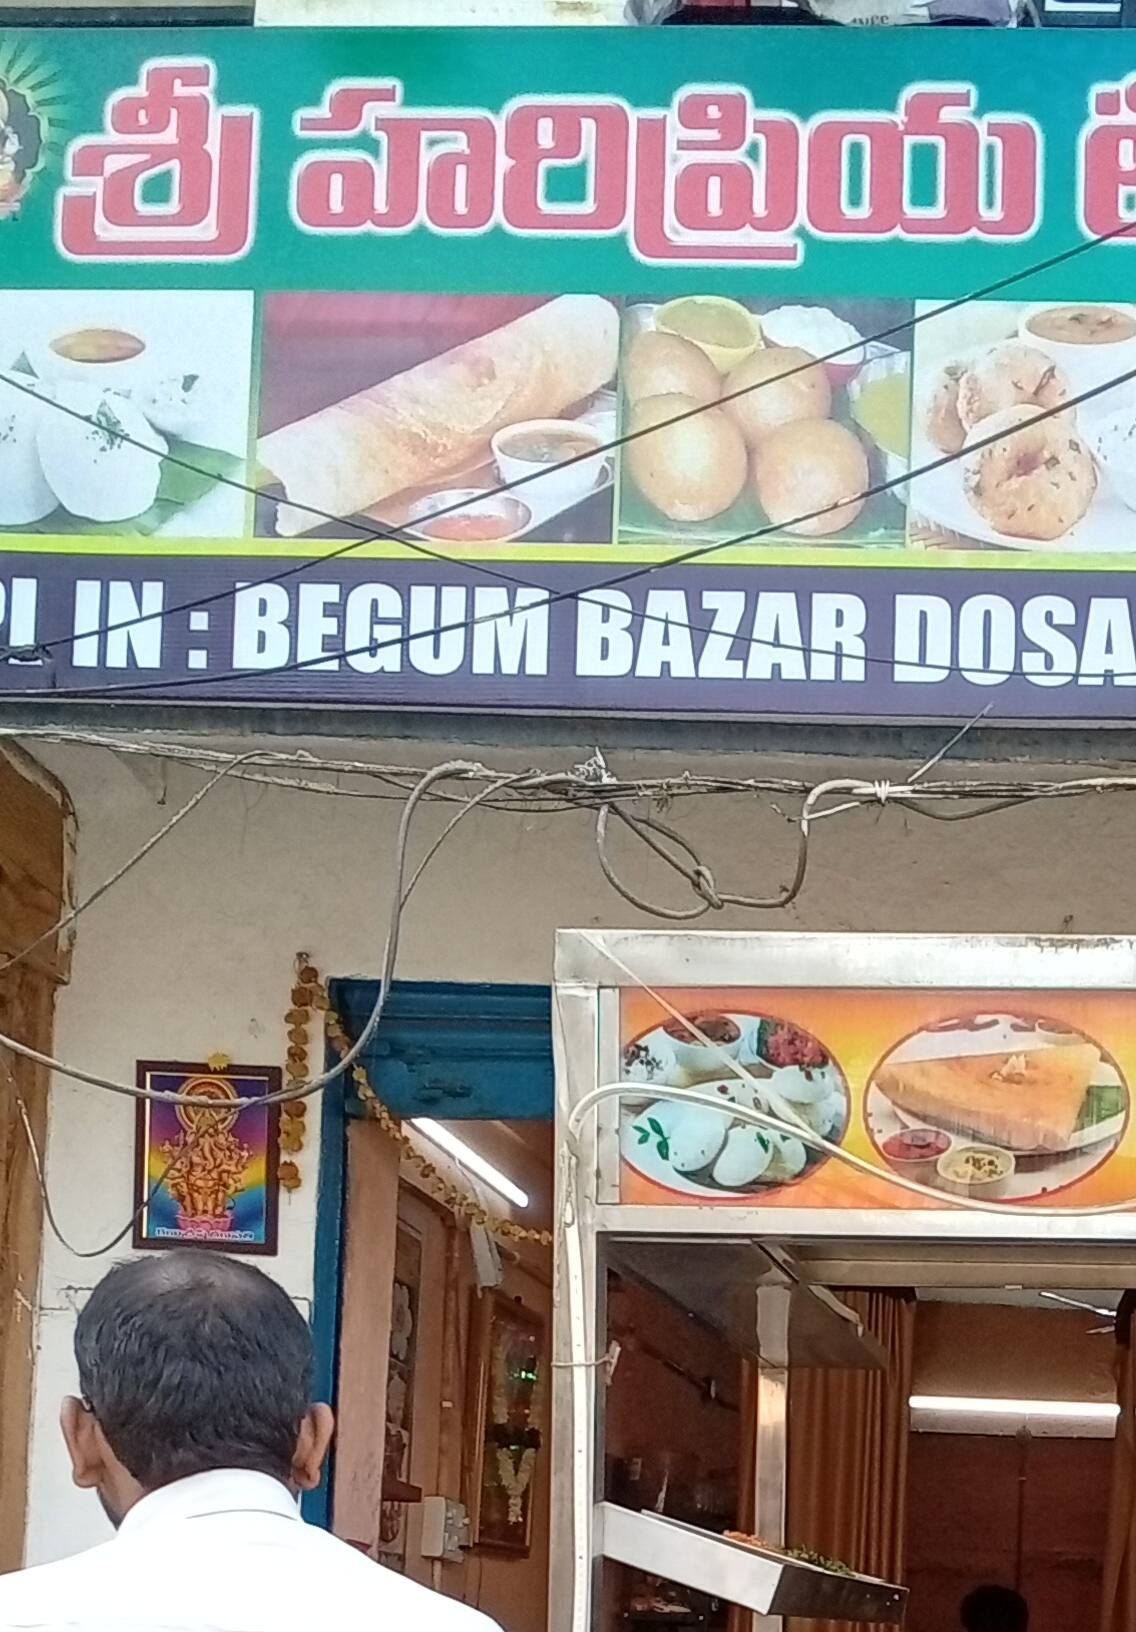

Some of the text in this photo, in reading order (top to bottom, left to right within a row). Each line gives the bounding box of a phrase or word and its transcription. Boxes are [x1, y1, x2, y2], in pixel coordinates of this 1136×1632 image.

[60, 62, 256, 257] శ్రీ
[72, 580, 164, 669] IN
[232, 581, 550, 676] BEGUM
[575, 589, 867, 682] BAZAR
